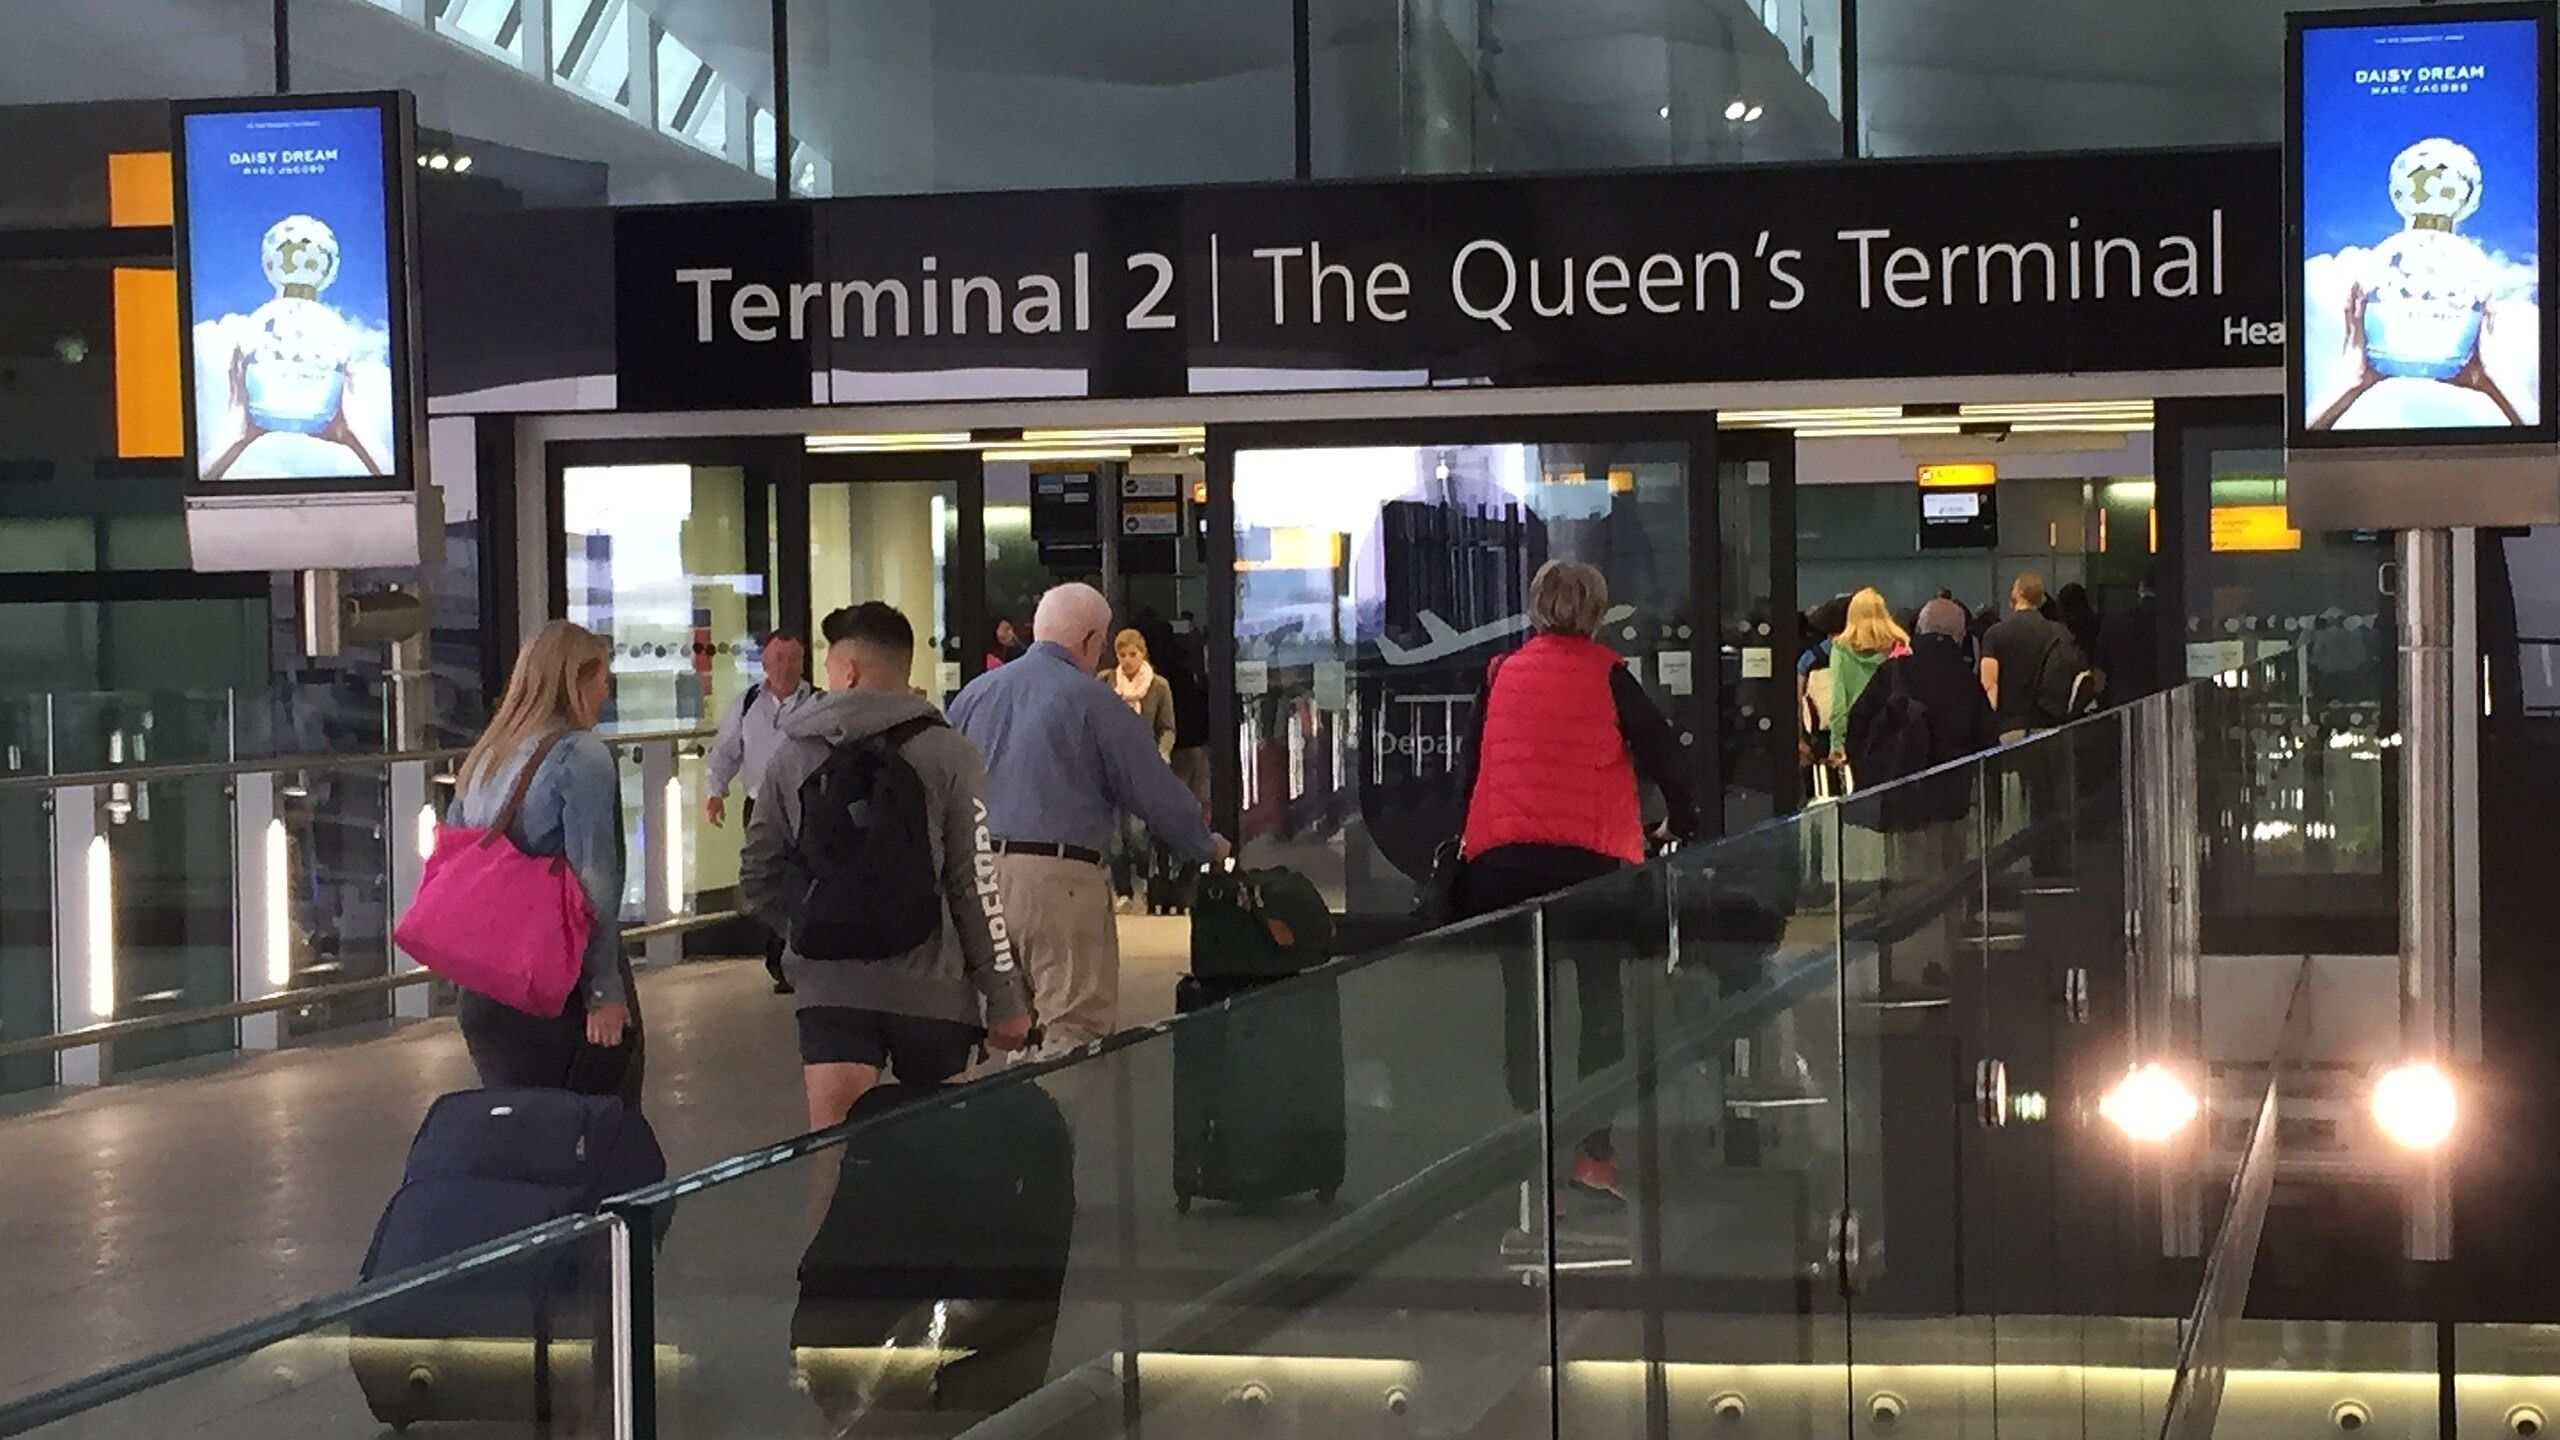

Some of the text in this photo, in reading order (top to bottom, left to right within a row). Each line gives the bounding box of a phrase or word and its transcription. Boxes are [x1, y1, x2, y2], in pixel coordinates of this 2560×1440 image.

[2355, 65, 2485, 84] DAISY DREAM
[228, 149, 339, 165] DAISY DREAM
[676, 209, 2222, 342] Terminal 2 The Queen's Terminal
